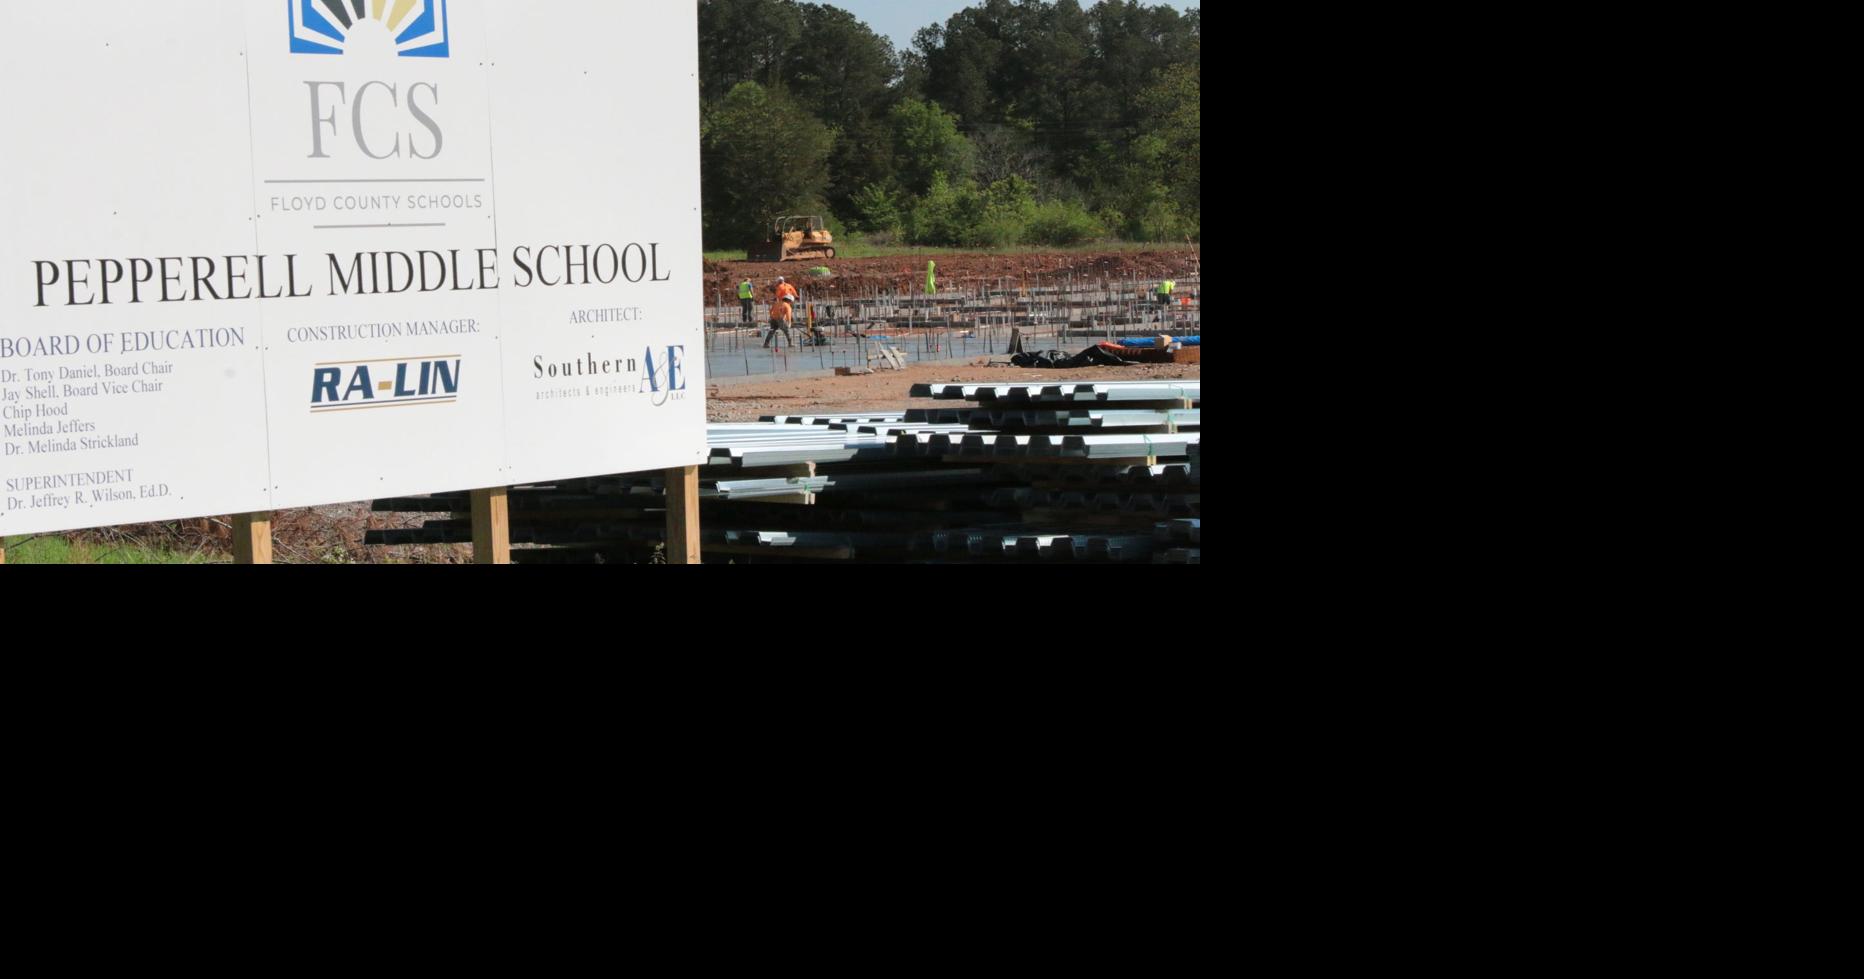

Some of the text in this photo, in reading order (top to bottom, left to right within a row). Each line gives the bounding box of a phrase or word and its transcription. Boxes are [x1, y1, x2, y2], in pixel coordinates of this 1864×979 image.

[303, 80, 443, 160] FCS
[270, 193, 483, 212] FLOYD COUNTY SCHOOLS
[32, 242, 671, 307] PEPPERELL MIDDLE SCHOOL
[569, 306, 643, 324] ARCHITECT:
[0, 326, 245, 358] BOARD OF EDUCATION
[287, 318, 480, 343] CONSTRUCTION MANAGER:
[1, 369, 21, 383] Dr.
[24, 367, 55, 383] Tony
[104, 362, 139, 377] Board
[142, 360, 173, 375] Chair
[533, 352, 636, 379] Southern
[2, 388, 21, 402] Jay
[63, 382, 98, 398] Board
[102, 381, 128, 395] Vice
[131, 378, 163, 393] Chair
[310, 359, 462, 403] RA-LIN
[536, 388, 581, 400] architects
[595, 383, 636, 397] engineers
[3, 402, 68, 421] Chip Hood
[4, 419, 96, 438] Melinda Jeffers
[5, 433, 139, 456] Dr. Melinda Strickland
[6, 469, 133, 492] SUPERINTENDENT
[7, 496, 26, 511] Dr.
[30, 492, 70, 508] Jeffrey
[75, 491, 87, 505] R.
[140, 483, 172, 498] Ed.D.
